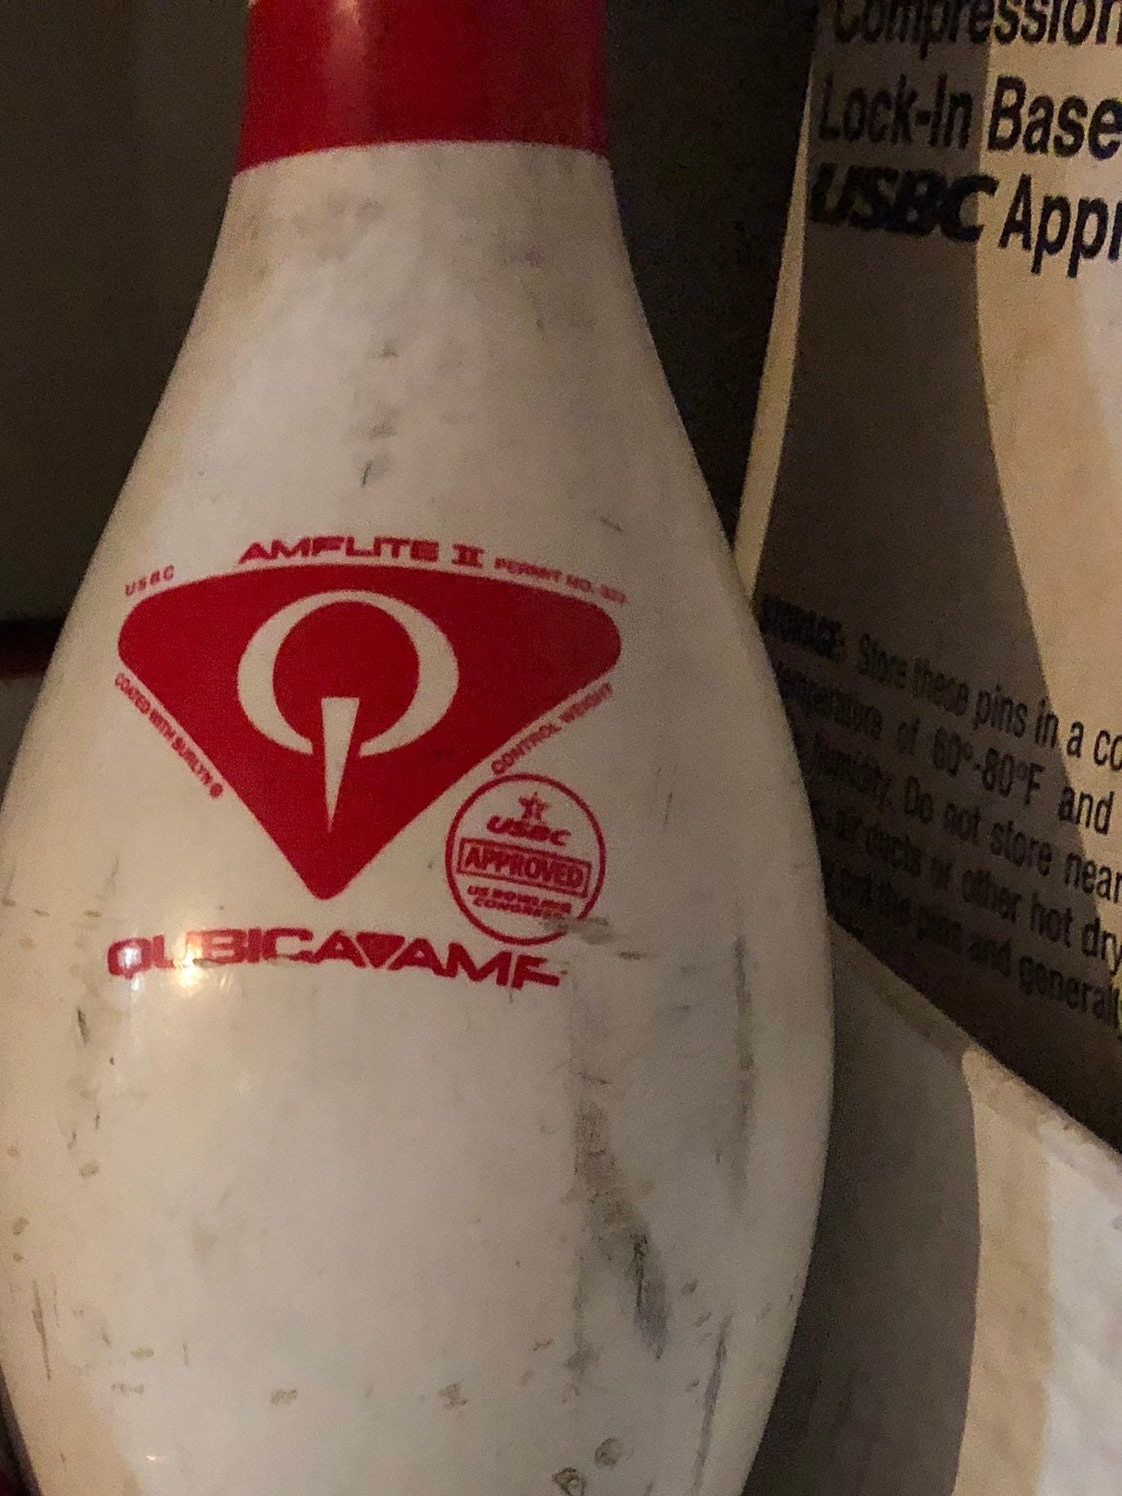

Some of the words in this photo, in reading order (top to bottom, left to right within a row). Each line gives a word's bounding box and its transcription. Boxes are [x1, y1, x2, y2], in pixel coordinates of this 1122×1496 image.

[835, 0, 1122, 60] Compression
[819, 72, 974, 150] Lock-In
[987, 75, 1122, 161] Base
[809, 162, 1000, 243] USBC
[238, 535, 440, 565] AMFLITE
[124, 565, 175, 597] USBC
[972, 684, 1028, 739] pins
[1034, 699, 1060, 749] in
[1066, 720, 1085, 759] a
[486, 815, 572, 847] USBC
[903, 775, 934, 825] Do
[990, 819, 1053, 877] store
[1064, 850, 1122, 905] near
[1057, 786, 1115, 836] and
[464, 845, 584, 889] APPROVED
[1028, 890, 1074, 949] hot
[1018, 954, 1122, 1042] generall
